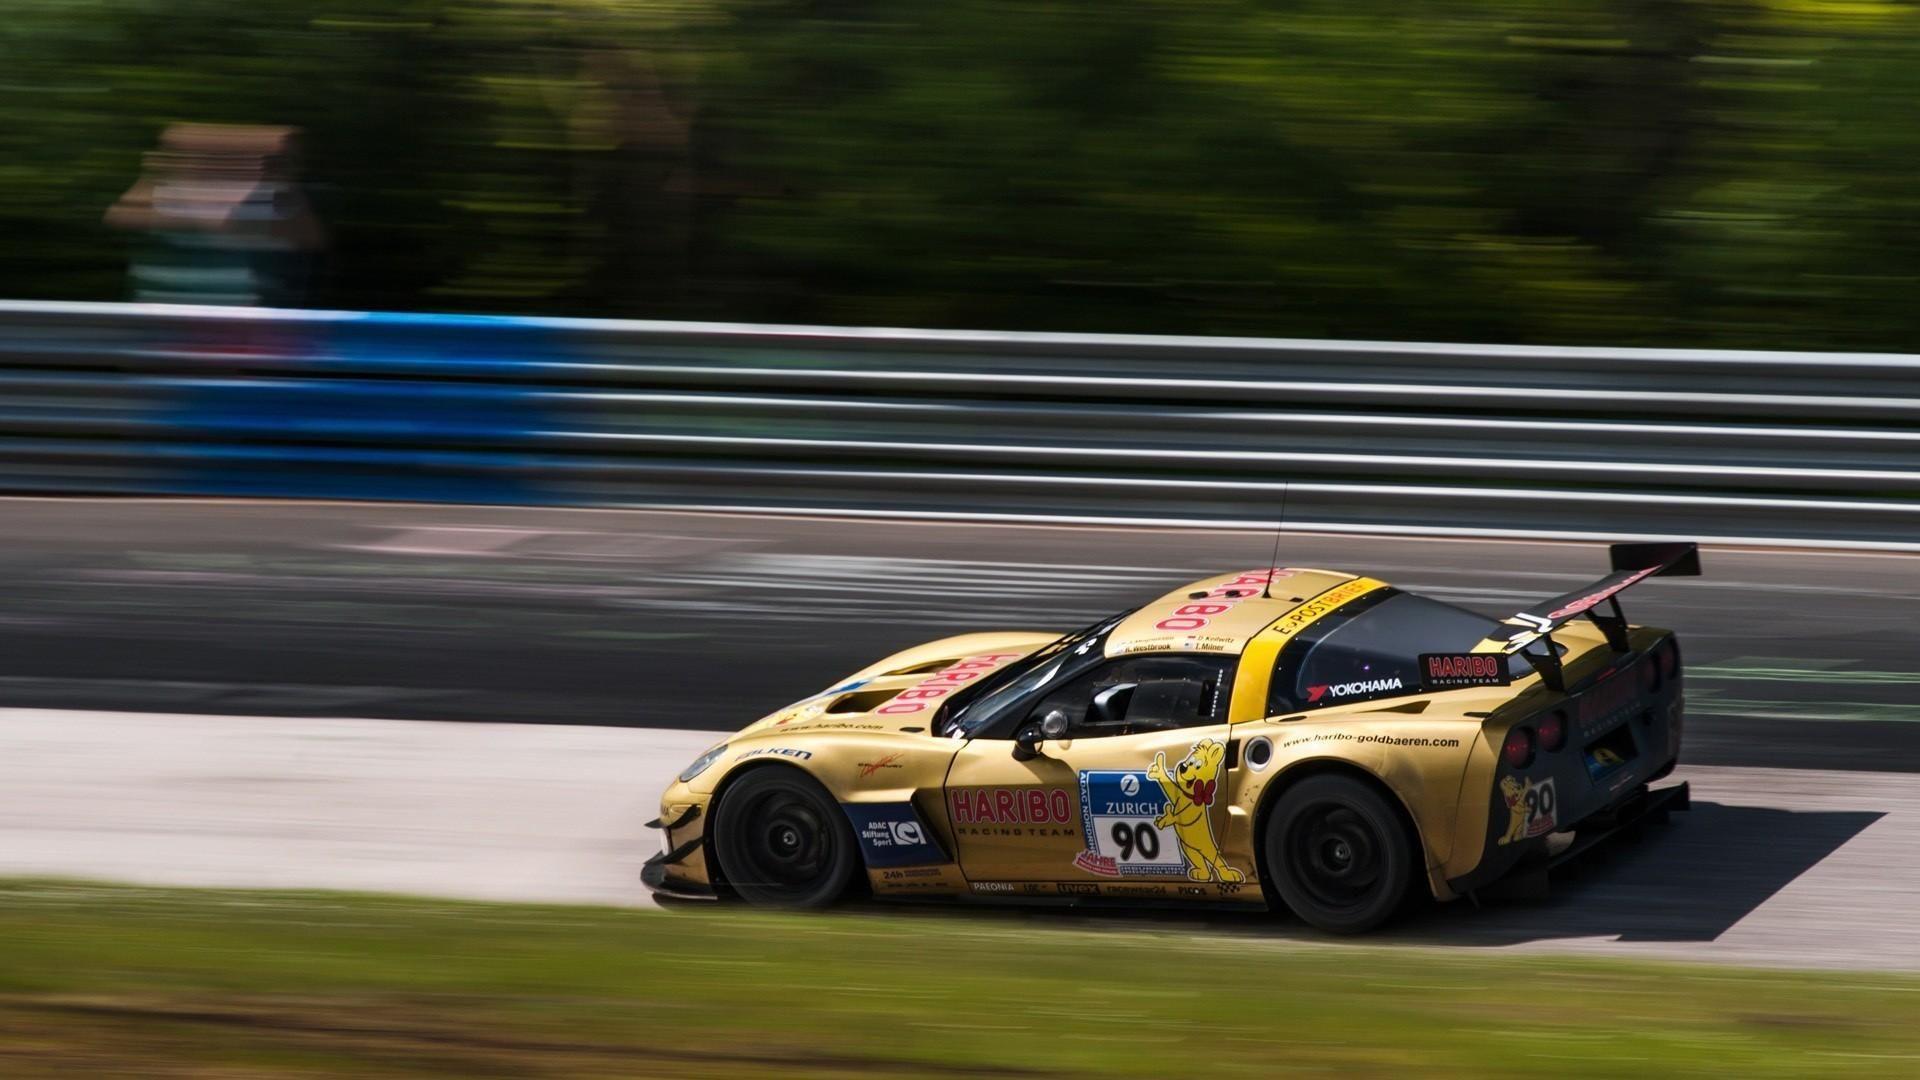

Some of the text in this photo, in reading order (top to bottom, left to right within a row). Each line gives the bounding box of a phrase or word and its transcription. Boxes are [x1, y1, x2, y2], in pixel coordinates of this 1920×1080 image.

[1428, 656, 1498, 678] HARIBO
[875, 652, 1022, 716] HARIBO
[1329, 677, 1402, 697] YOKOHAMA
[1283, 732, 1460, 749] www.haribo-goldbaeren.com
[1080, 771, 1088, 803] ADAC
[950, 788, 1072, 825] HARIBO
[1106, 802, 1158, 815] ZURICH
[1524, 782, 1555, 824] 90
[861, 830, 890, 839] Stiftung
[868, 821, 887, 830] ADAC
[958, 828, 1075, 836] RACING TEAM
[872, 838, 892, 847] Sport
[1111, 821, 1161, 862] 90
